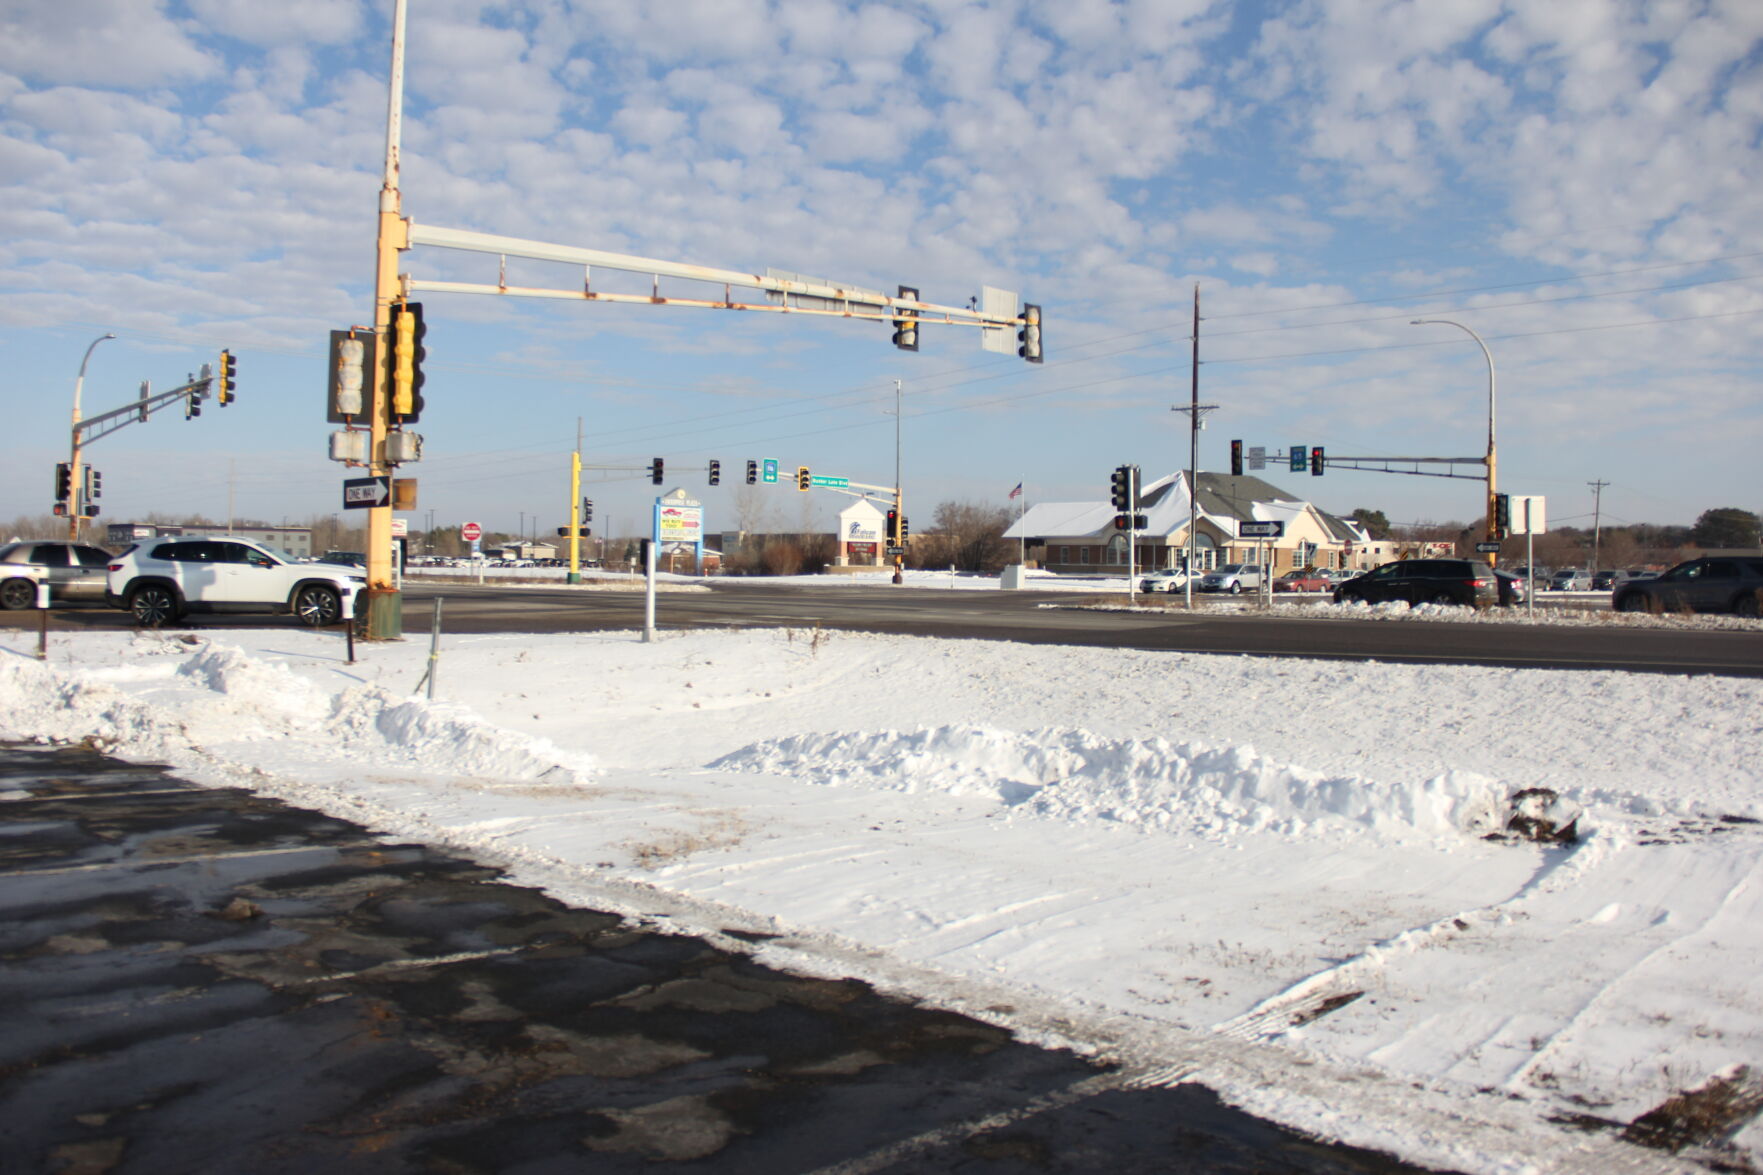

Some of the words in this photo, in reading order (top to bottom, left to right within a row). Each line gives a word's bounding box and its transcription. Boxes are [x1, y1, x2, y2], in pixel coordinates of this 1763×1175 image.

[349, 487, 361, 500] ONE
[362, 486, 376, 499] WAY
[1243, 525, 1255, 533] ONE
[1256, 525, 1269, 533] WAY
